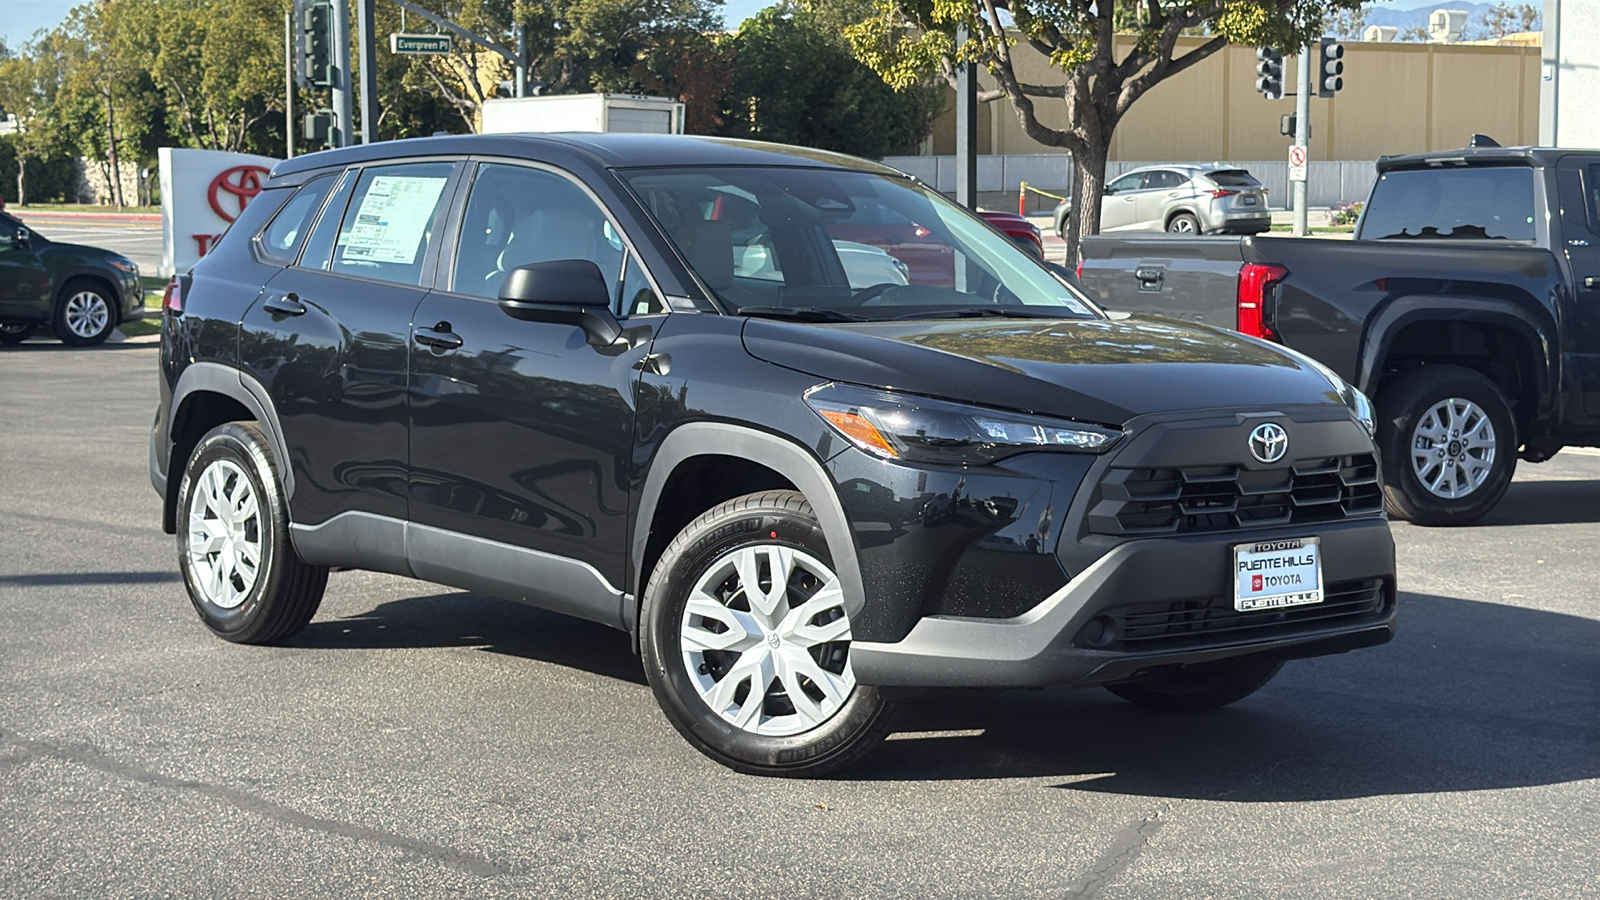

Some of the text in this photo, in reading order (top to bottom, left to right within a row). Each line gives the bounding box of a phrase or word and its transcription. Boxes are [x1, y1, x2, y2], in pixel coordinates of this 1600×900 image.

[398, 39, 448, 51] Evergreen Pl
[192, 234, 221, 257] T
[1256, 540, 1300, 551] TOYOTA
[1239, 554, 1314, 572] PUENTE HILLS
[1265, 574, 1302, 587] TOYOTA
[1243, 592, 1318, 609] PUENTE HILLS
